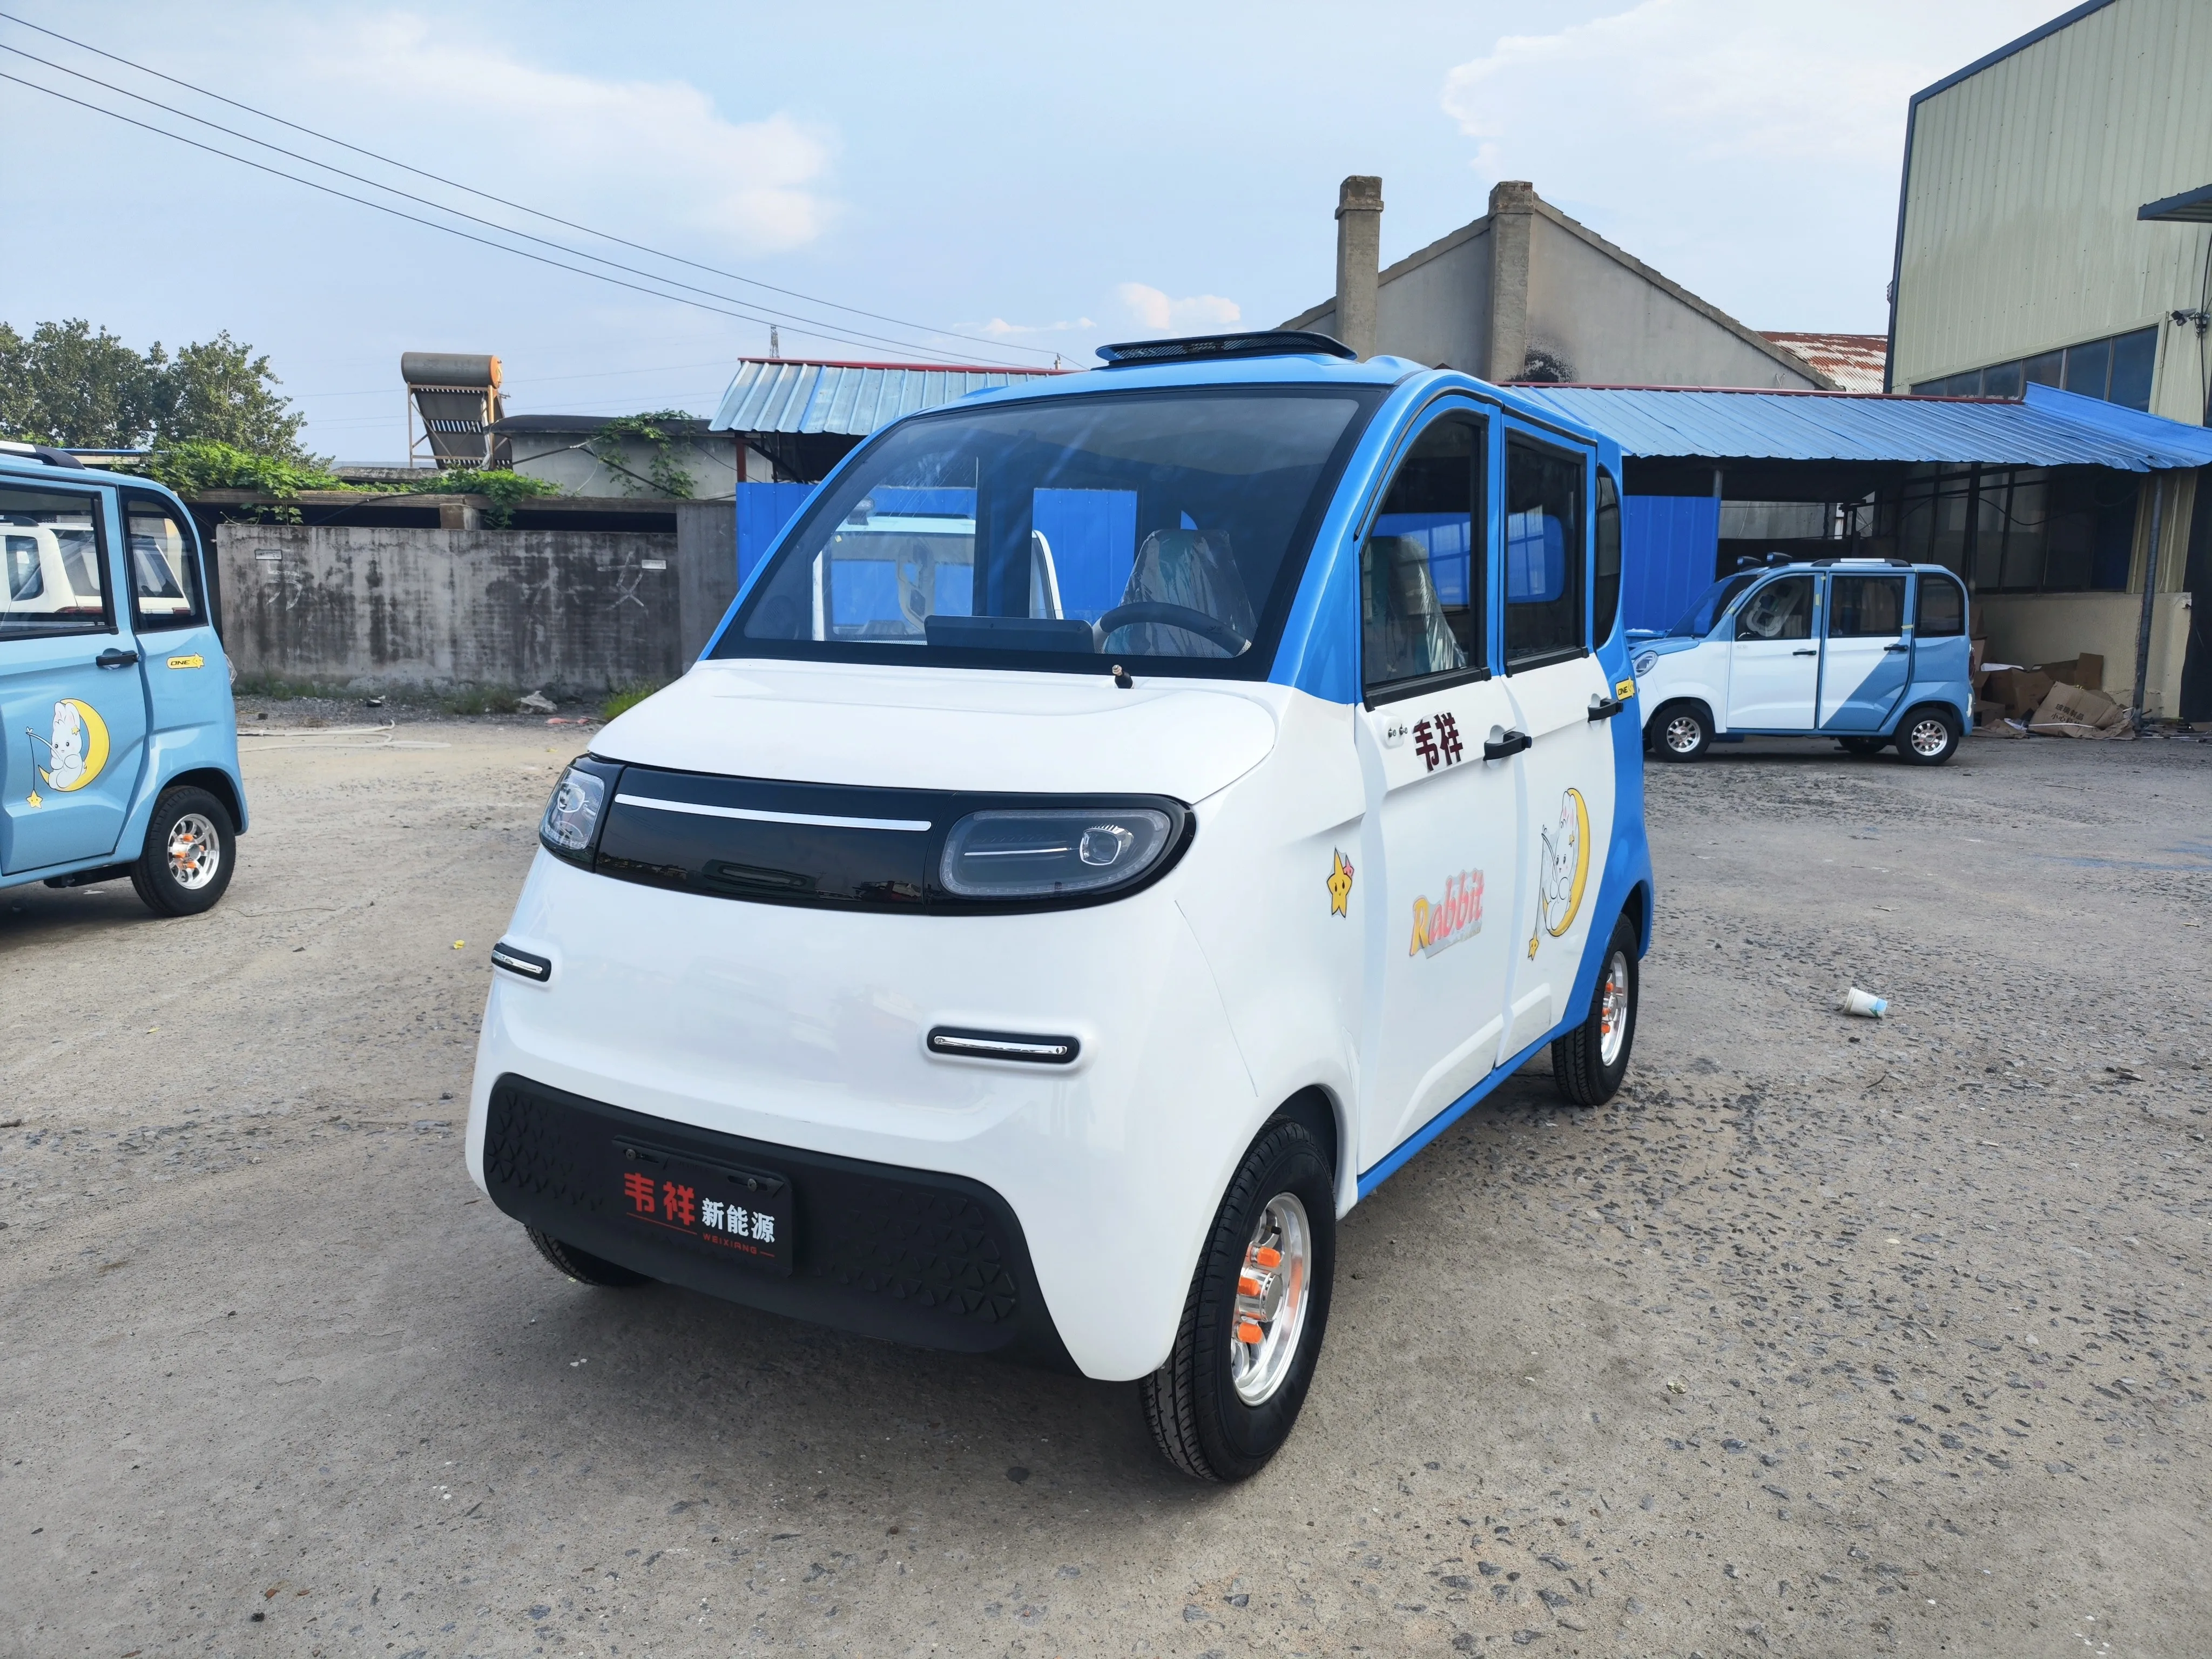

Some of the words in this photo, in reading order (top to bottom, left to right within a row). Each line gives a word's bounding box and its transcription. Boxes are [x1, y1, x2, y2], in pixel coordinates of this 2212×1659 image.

[1618, 686, 1628, 696] ONE
[1413, 712, 1464, 772] 韦祥
[1409, 870, 1484, 957] Rabbit
[624, 1172, 696, 1226] 韦祥
[702, 1198, 775, 1243] 新能源
[703, 1233, 758, 1255] WEIXIANG
